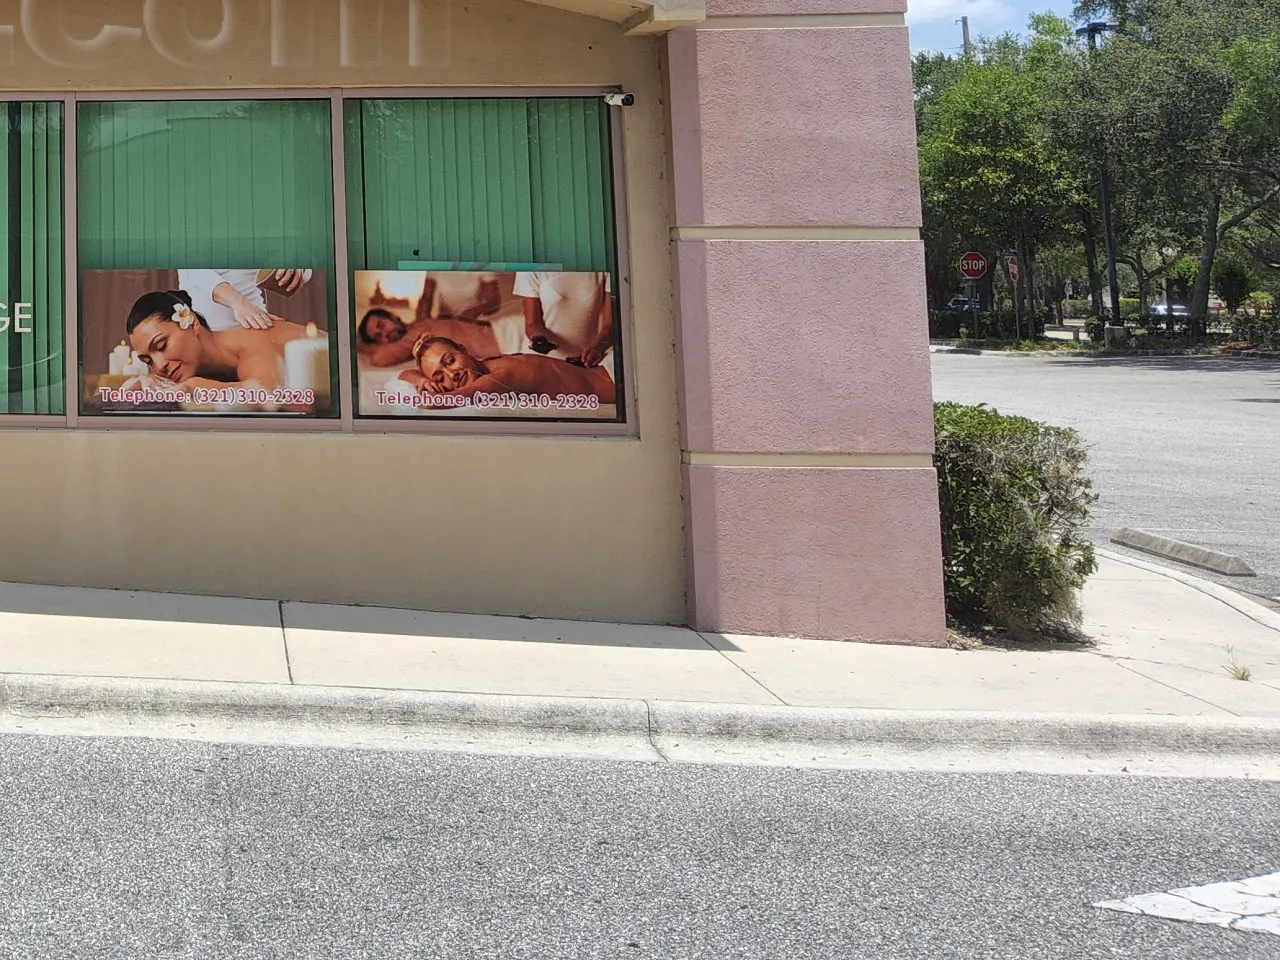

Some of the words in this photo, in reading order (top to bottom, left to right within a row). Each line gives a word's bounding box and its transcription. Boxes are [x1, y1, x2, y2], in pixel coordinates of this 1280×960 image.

[962, 260, 985, 270] STOP
[99, 386, 191, 405] Telephone:
[374, 390, 471, 408] Telephone:
